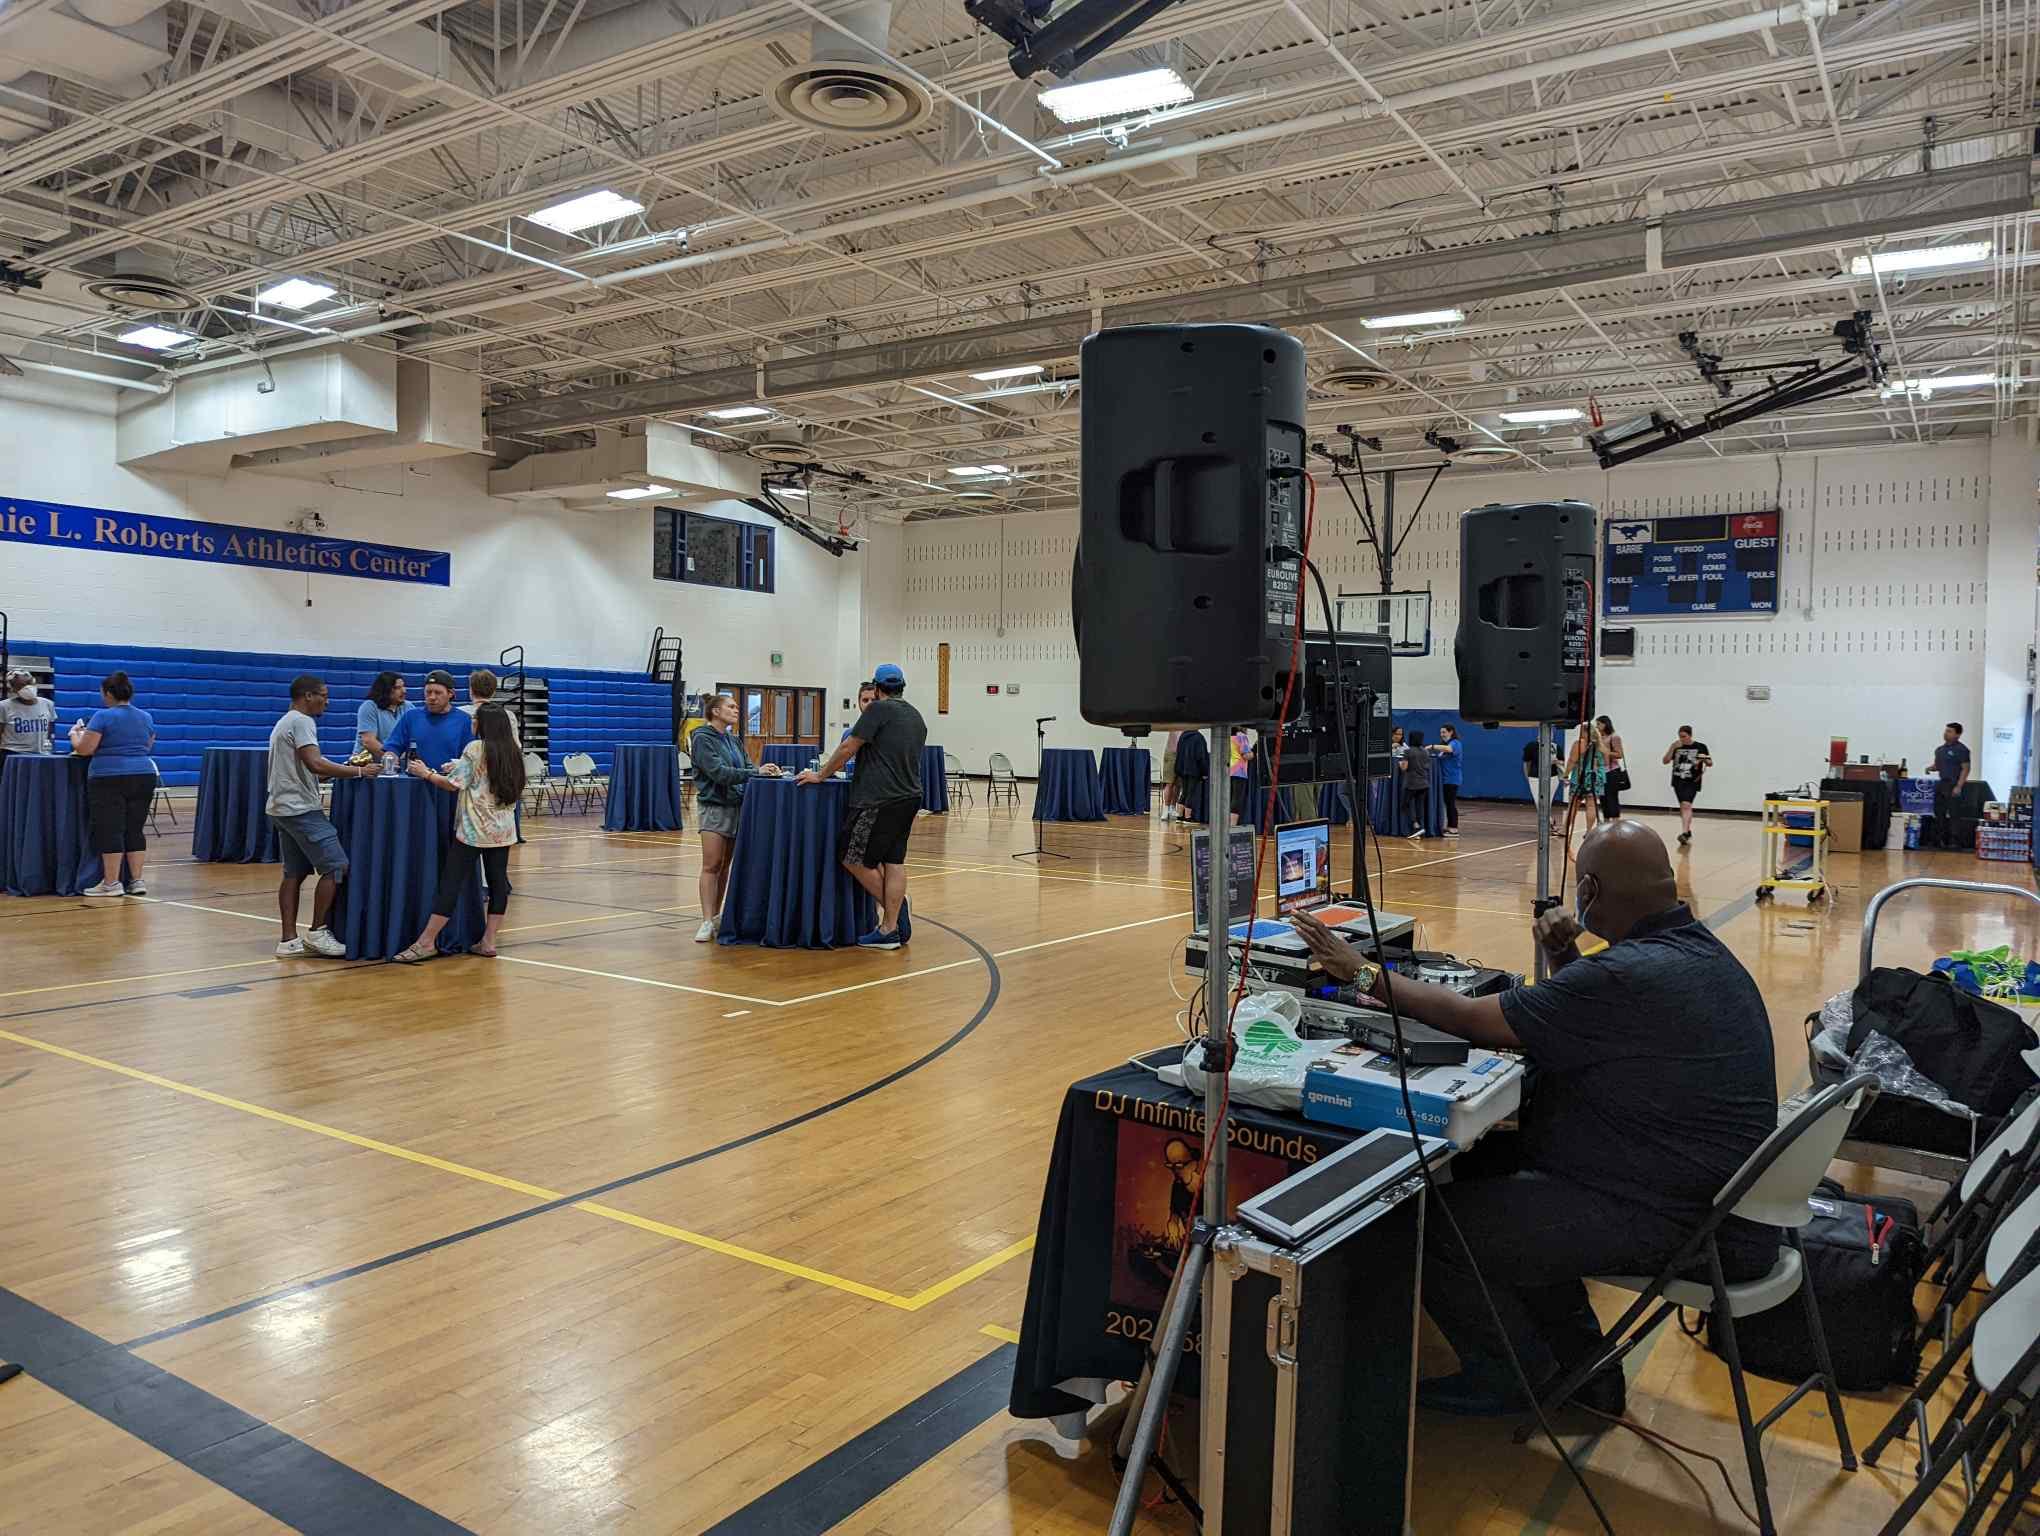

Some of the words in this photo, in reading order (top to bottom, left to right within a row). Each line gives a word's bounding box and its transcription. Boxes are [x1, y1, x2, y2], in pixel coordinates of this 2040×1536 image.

[48, 511, 82, 540] L.
[92, 516, 215, 554] Roberts
[222, 533, 341, 568] Athletics
[349, 548, 431, 578] Center
[1734, 537, 1776, 549] GUEST
[1615, 544, 1643, 554] BARRIE
[1673, 545, 1704, 553] PERIOD
[1267, 568, 1299, 582] EUROLIVE
[1607, 576, 1633, 584] FOULS
[1667, 574, 1698, 582] PLAYER
[1702, 573, 1725, 581] FOUL
[1747, 571, 1776, 579] FOULS
[1691, 603, 1717, 611] GAME
[1750, 601, 1772, 609] WON
[14, 715, 48, 733] Barrie
[1308, 1090, 1353, 1108] gemini
[1095, 1089, 1127, 1114] DJ
[1134, 1097, 1206, 1132] Infinite
